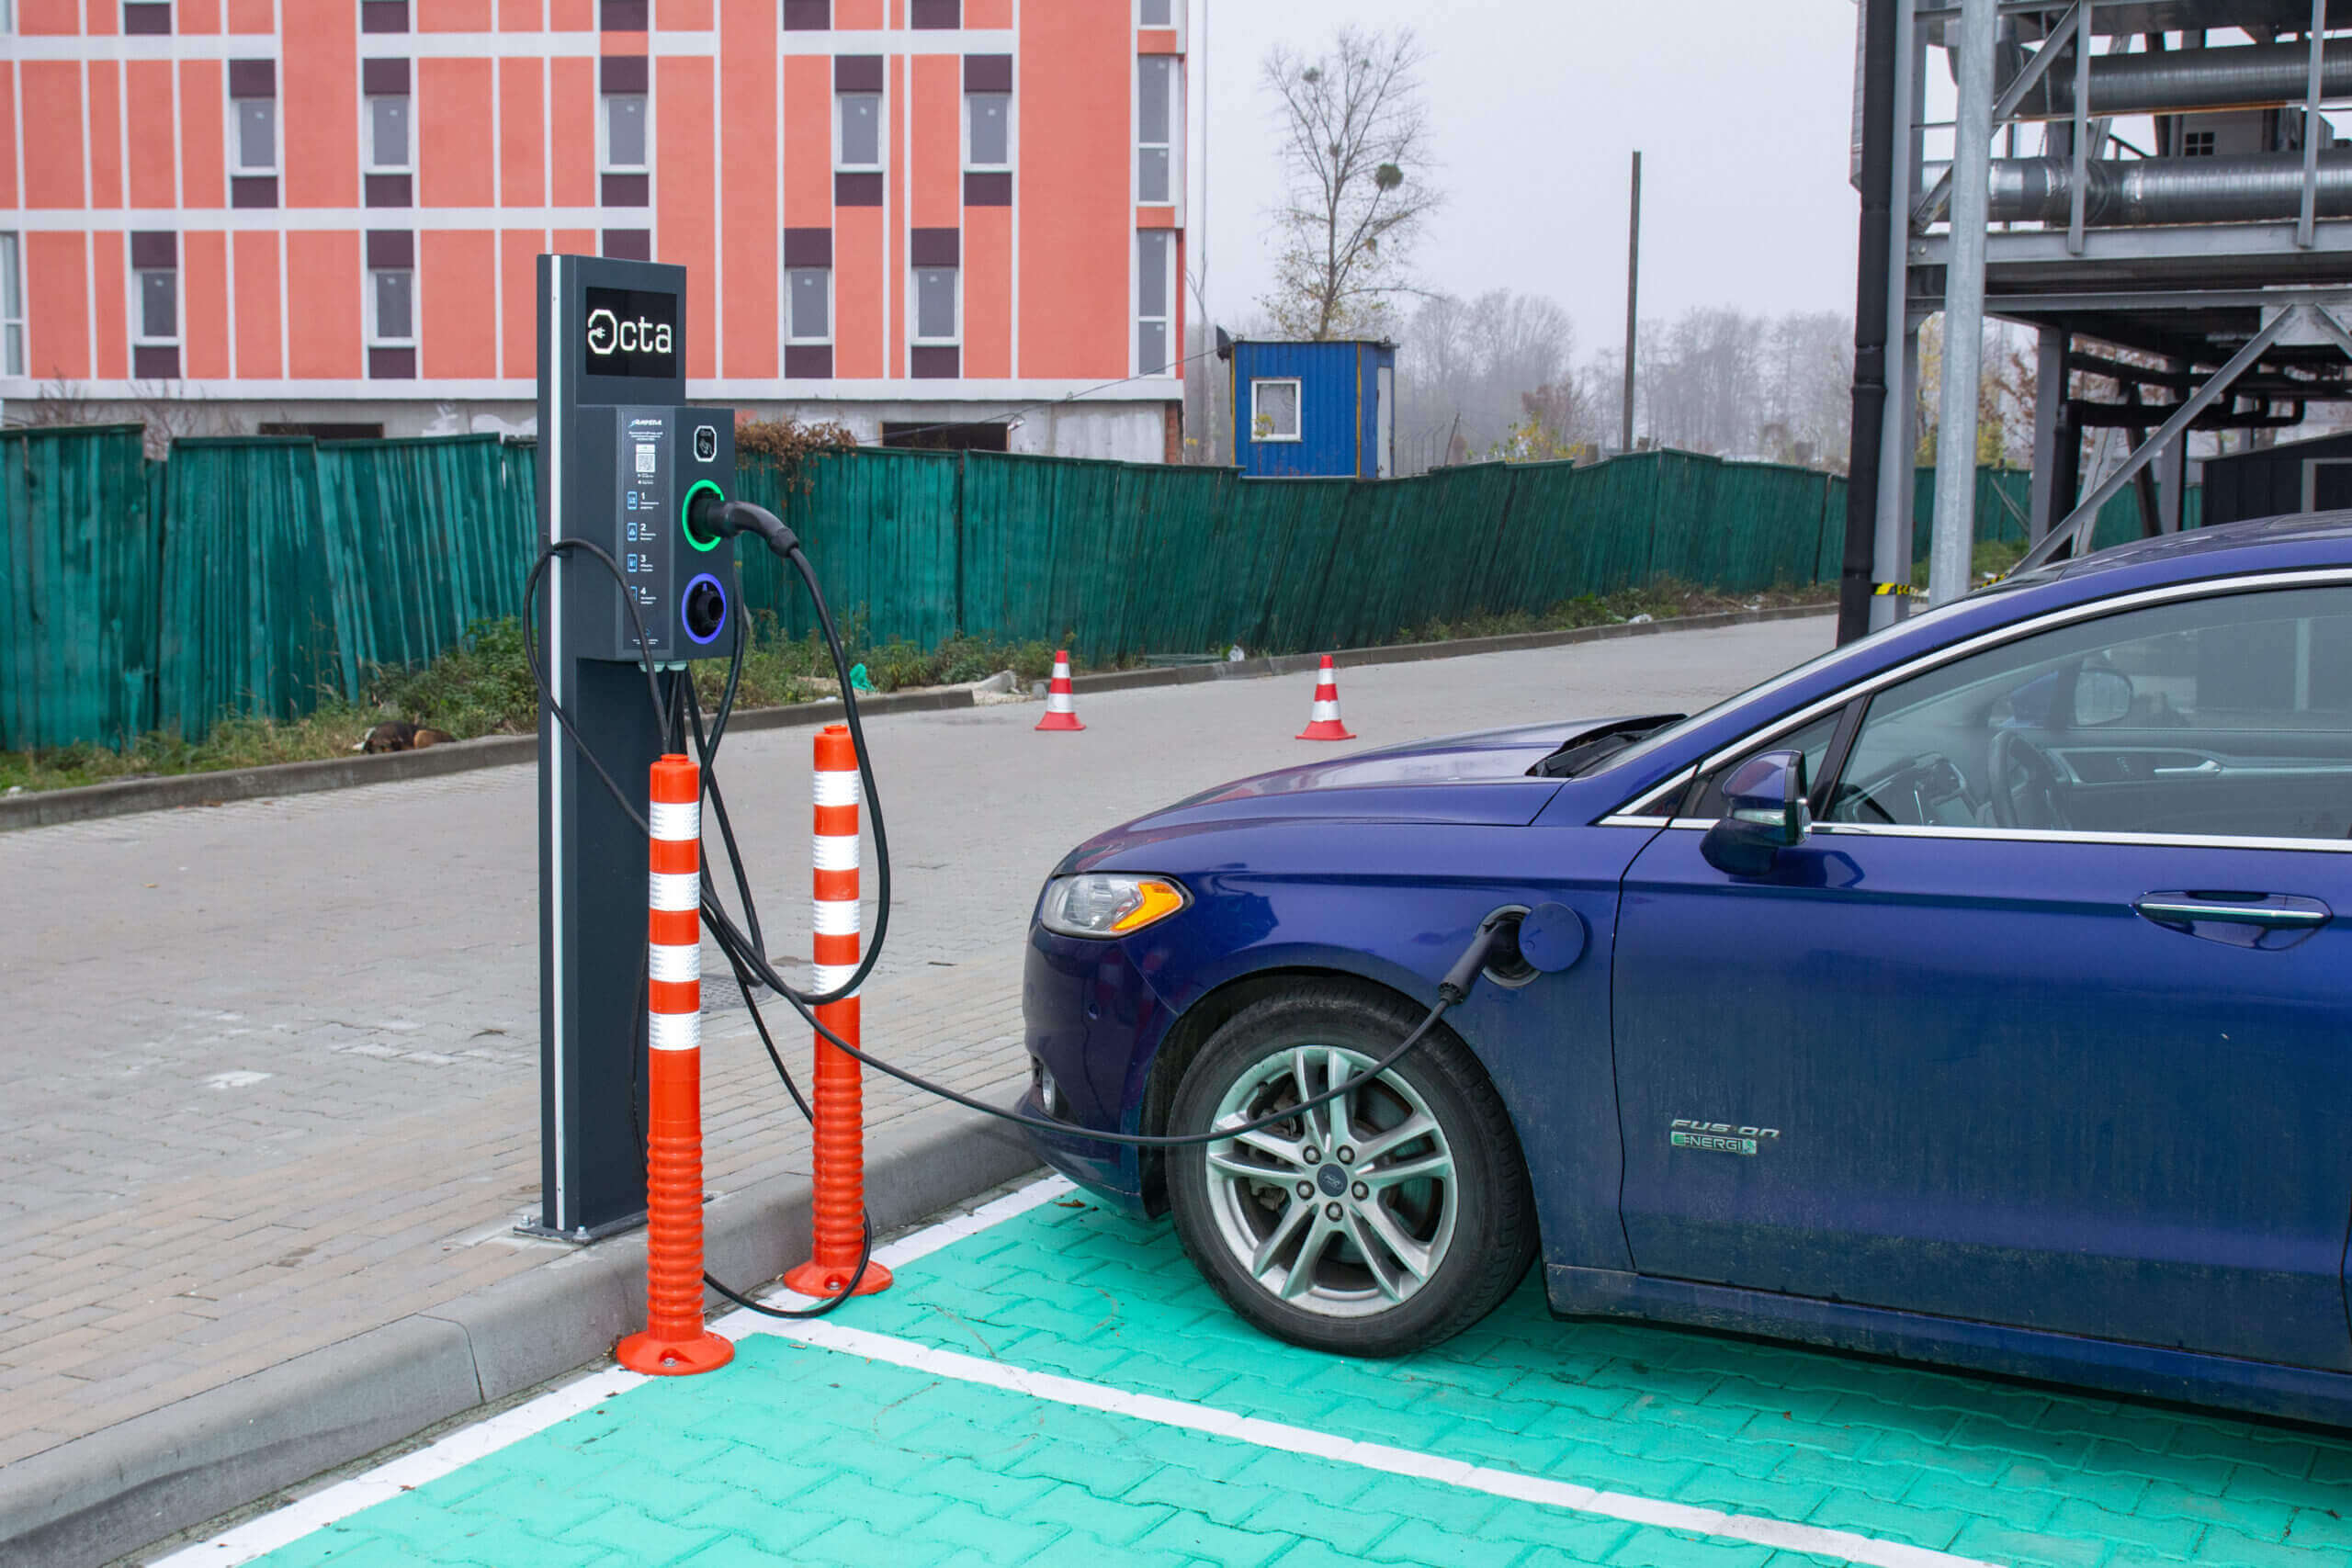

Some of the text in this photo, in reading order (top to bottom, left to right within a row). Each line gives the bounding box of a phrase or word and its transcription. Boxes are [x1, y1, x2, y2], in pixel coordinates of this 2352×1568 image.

[587, 309, 673, 355] Octa
[640, 491, 646, 500] 1
[640, 523, 647, 531] 2
[640, 554, 647, 562] 3
[640, 587, 647, 595] 4
[1670, 1119, 1780, 1137] FUSON
